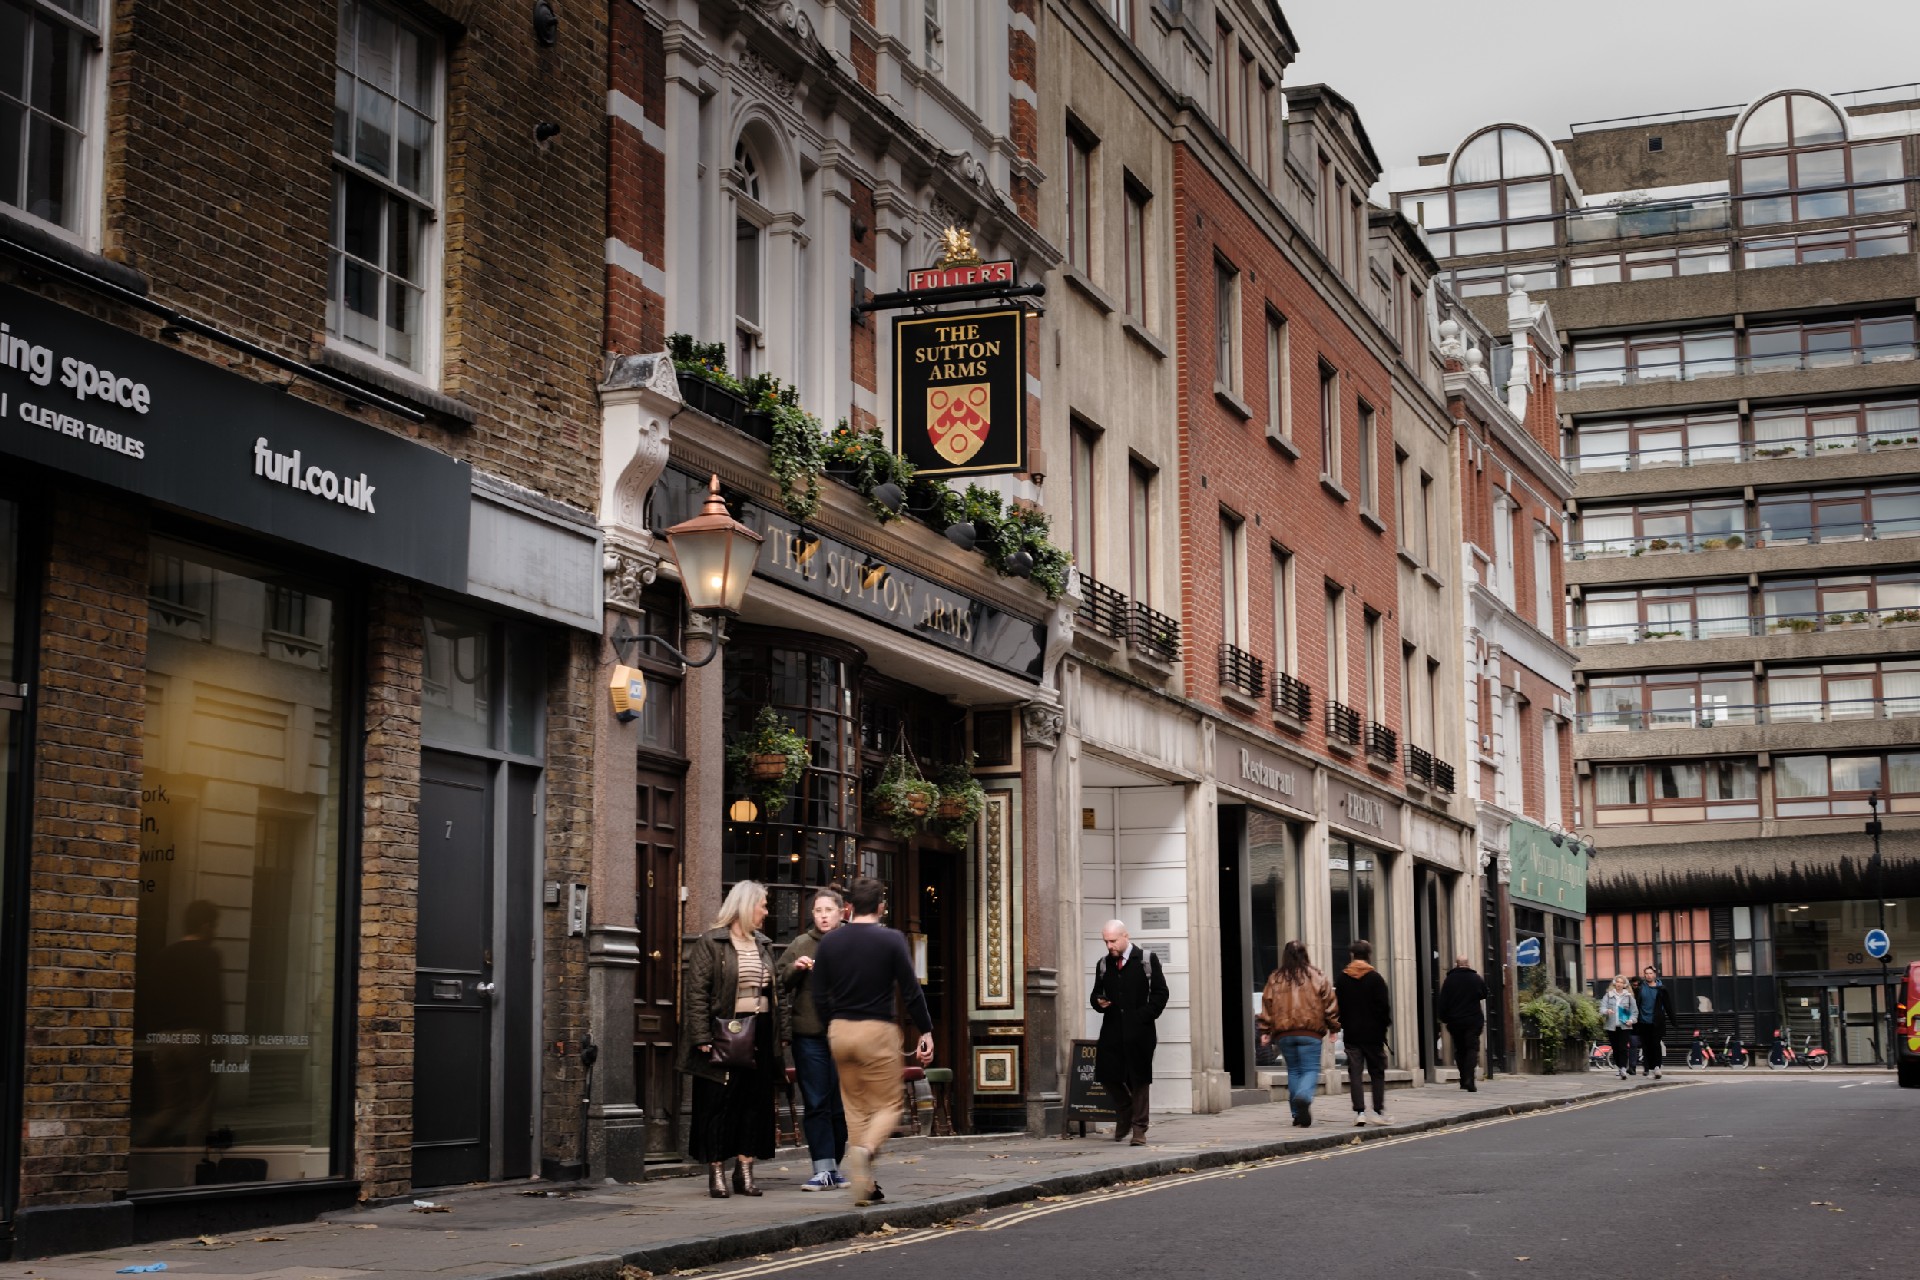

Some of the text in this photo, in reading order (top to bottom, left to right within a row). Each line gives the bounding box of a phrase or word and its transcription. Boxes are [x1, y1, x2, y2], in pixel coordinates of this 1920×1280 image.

[914, 263, 1007, 289] FULLER'S
[934, 324, 980, 342] THE
[915, 340, 1001, 363] SUTTON
[928, 360, 987, 381] ARMS
[60, 356, 150, 414] space
[19, 402, 145, 460] CLEVER TABLES
[255, 436, 376, 514] furl.co.uk
[767, 524, 972, 643] THE SUTTON ARMS
[1241, 748, 1295, 796] Restaurant
[445, 820, 453, 839] 7
[647, 870, 654, 888] 6
[1847, 953, 1863, 964] 99
[145, 1033, 309, 1046] STORAGE BEDS SOFA BEDS CLEVER TABLES
[210, 1059, 250, 1073] furl.co.uk
